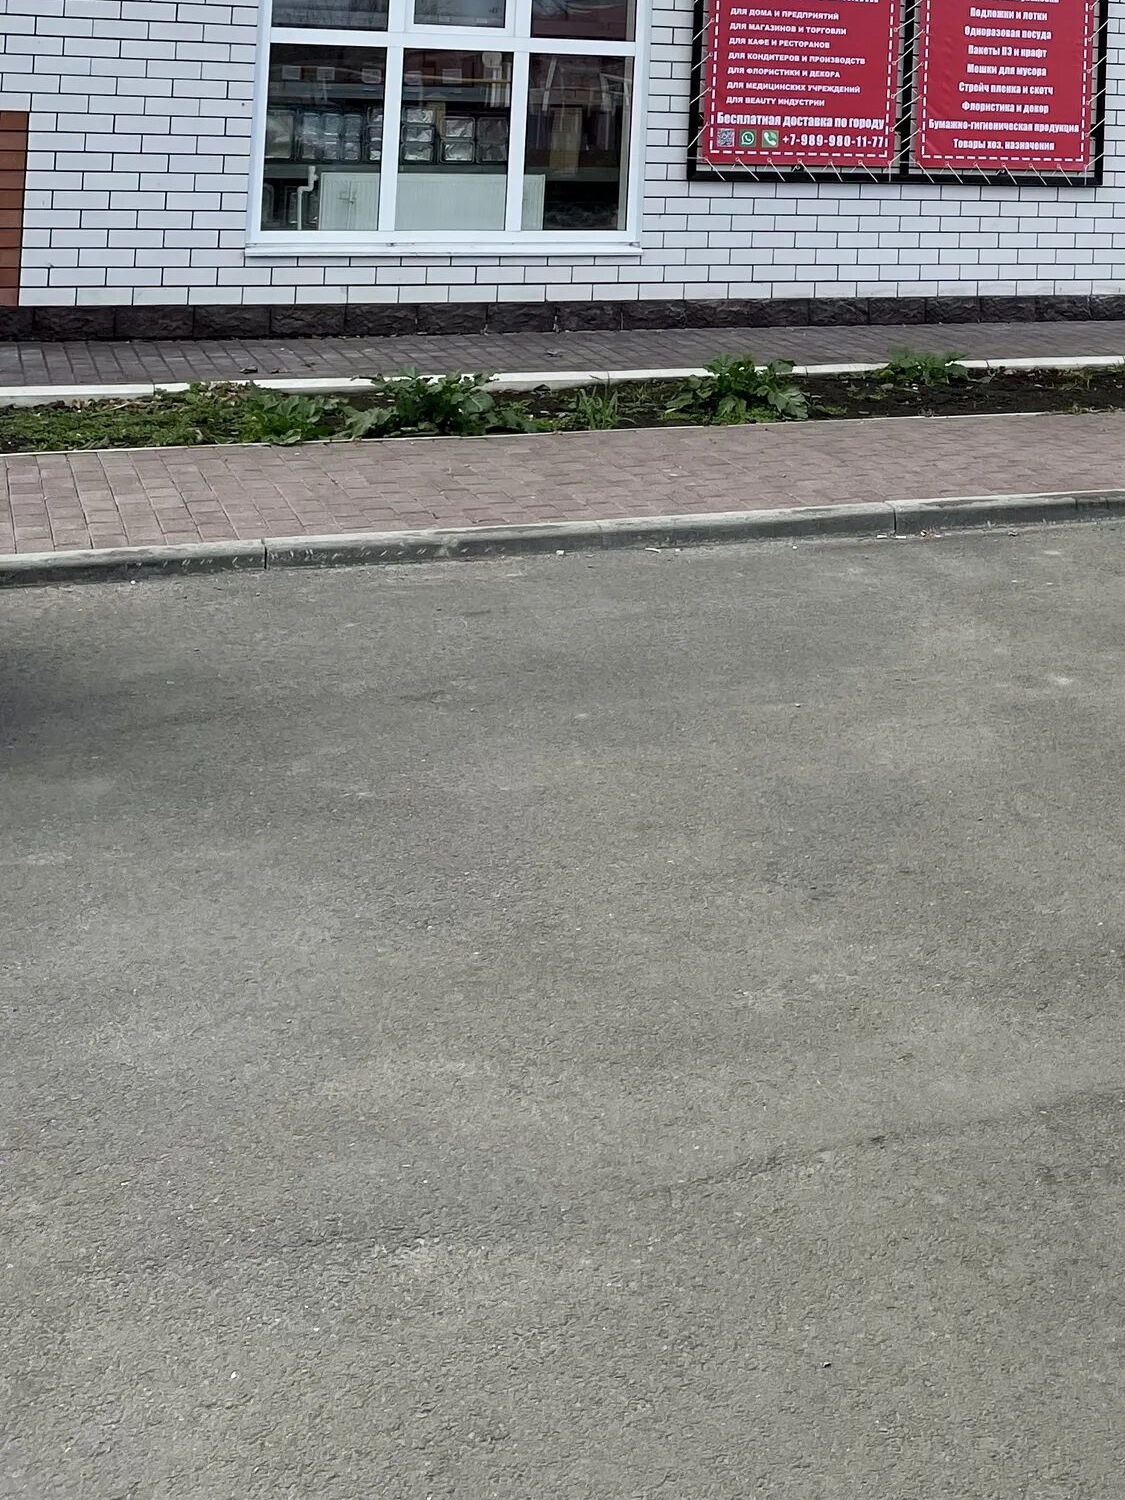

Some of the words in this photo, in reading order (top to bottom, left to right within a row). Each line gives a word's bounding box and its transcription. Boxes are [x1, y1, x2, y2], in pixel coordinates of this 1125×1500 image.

[730, 8, 747, 16] ДЛЯ
[749, 9, 772, 17] ДОМА
[782, 11, 839, 20] ПРЕДПРИЯТИЙ
[970, 7, 1014, 19] Подложки
[1016, 10, 1021, 19] и
[1023, 10, 1047, 21] лотки
[729, 23, 746, 31] ДЛЯ
[748, 24, 796, 32] МАГАЗИНОВ
[805, 26, 847, 35] ТОРГОВЛИ
[964, 25, 1020, 38] Одноразовая
[1021, 30, 1052, 40] посуда
[729, 37, 746, 45] ДЛЯ
[748, 38, 769, 46] КАФЕ
[779, 39, 830, 49] РЕСТОРАНОВ
[968, 45, 1000, 56] Пакеты
[1002, 45, 1012, 56] ПЭ
[1014, 47, 1019, 56] и
[1021, 47, 1047, 58] крафт
[728, 52, 745, 60] ДЛЯ
[747, 52, 800, 62] КОНДИТЕРОВ
[809, 56, 866, 65] ПРОИЗВОДСТВ
[746, 67, 800, 77] ФЛОРИСТИКИ
[802, 69, 808, 77] И
[809, 70, 840, 78] ДЕКОРА
[967, 63, 997, 74] Мешки
[998, 66, 1015, 76] для
[1016, 66, 1046, 77] мусора
[727, 81, 744, 89] ДЛЯ
[746, 82, 806, 91] МЕДИЦИНСКИХ
[807, 84, 860, 93] УЧРЕЖДЕНИЙ
[726, 96, 743, 104] ДЛЯ
[745, 97, 776, 105] BEAUTY
[777, 98, 825, 107] ИНДУСТРИИ
[962, 101, 1014, 112] Флористика
[1016, 103, 1022, 113] и
[1023, 103, 1049, 114] декор
[717, 112, 781, 126] Бесплатная
[783, 115, 832, 128] доставка
[834, 118, 847, 128] по
[849, 118, 885, 130] городу
[783, 134, 884, 148] +7-989-980-11-77
[953, 138, 986, 150] Товары
[987, 140, 1003, 150] хоз.
[1005, 141, 1054, 151] назначения
